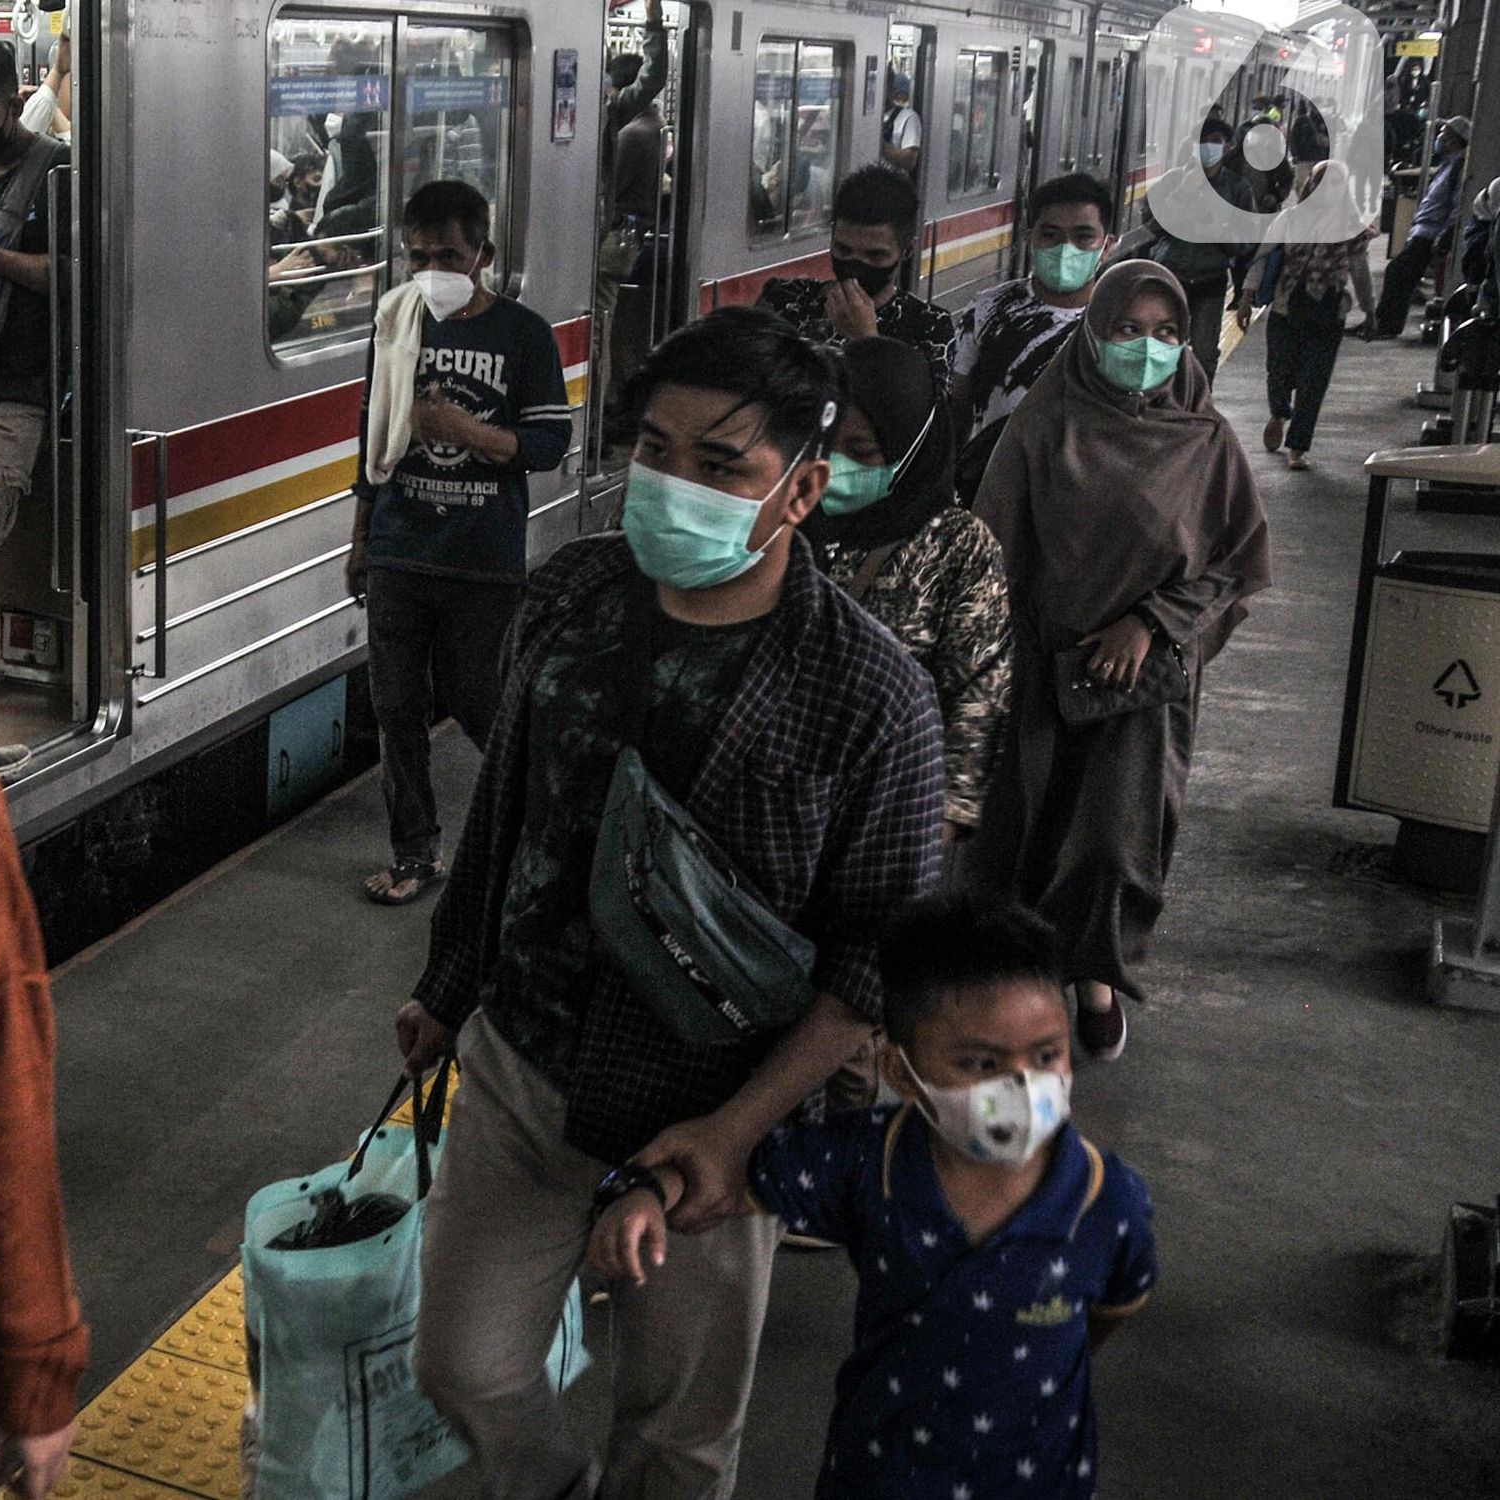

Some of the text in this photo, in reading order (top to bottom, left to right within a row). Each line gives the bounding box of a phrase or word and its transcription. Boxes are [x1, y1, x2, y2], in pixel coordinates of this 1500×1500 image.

[418, 346, 508, 396] PCURL
[1414, 720, 1493, 744] Other waste
[660, 933, 693, 967] NIKE
